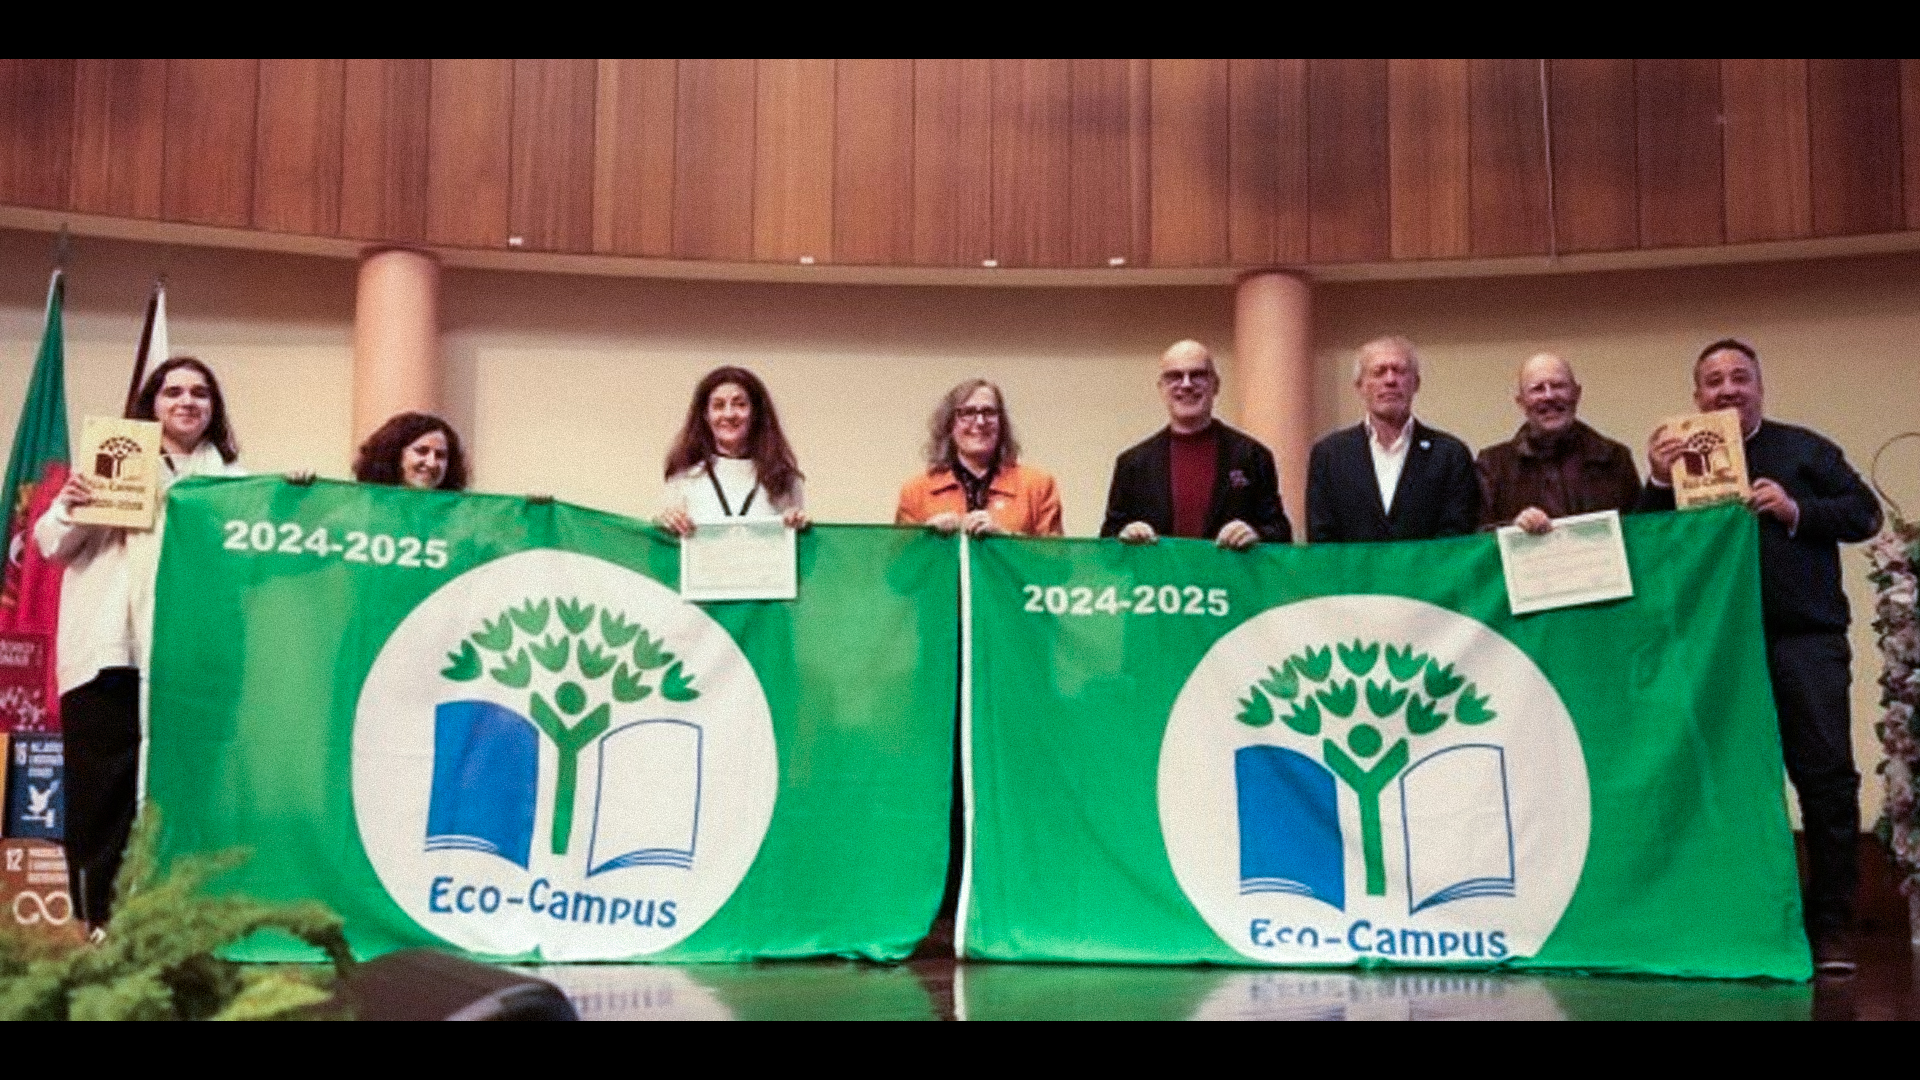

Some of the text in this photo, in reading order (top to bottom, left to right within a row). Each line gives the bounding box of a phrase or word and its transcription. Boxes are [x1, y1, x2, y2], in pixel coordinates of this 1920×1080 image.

[223, 520, 449, 568] 2024-2025
[1023, 584, 1229, 616] 2024-2025
[429, 876, 677, 928] Eco-Campus
